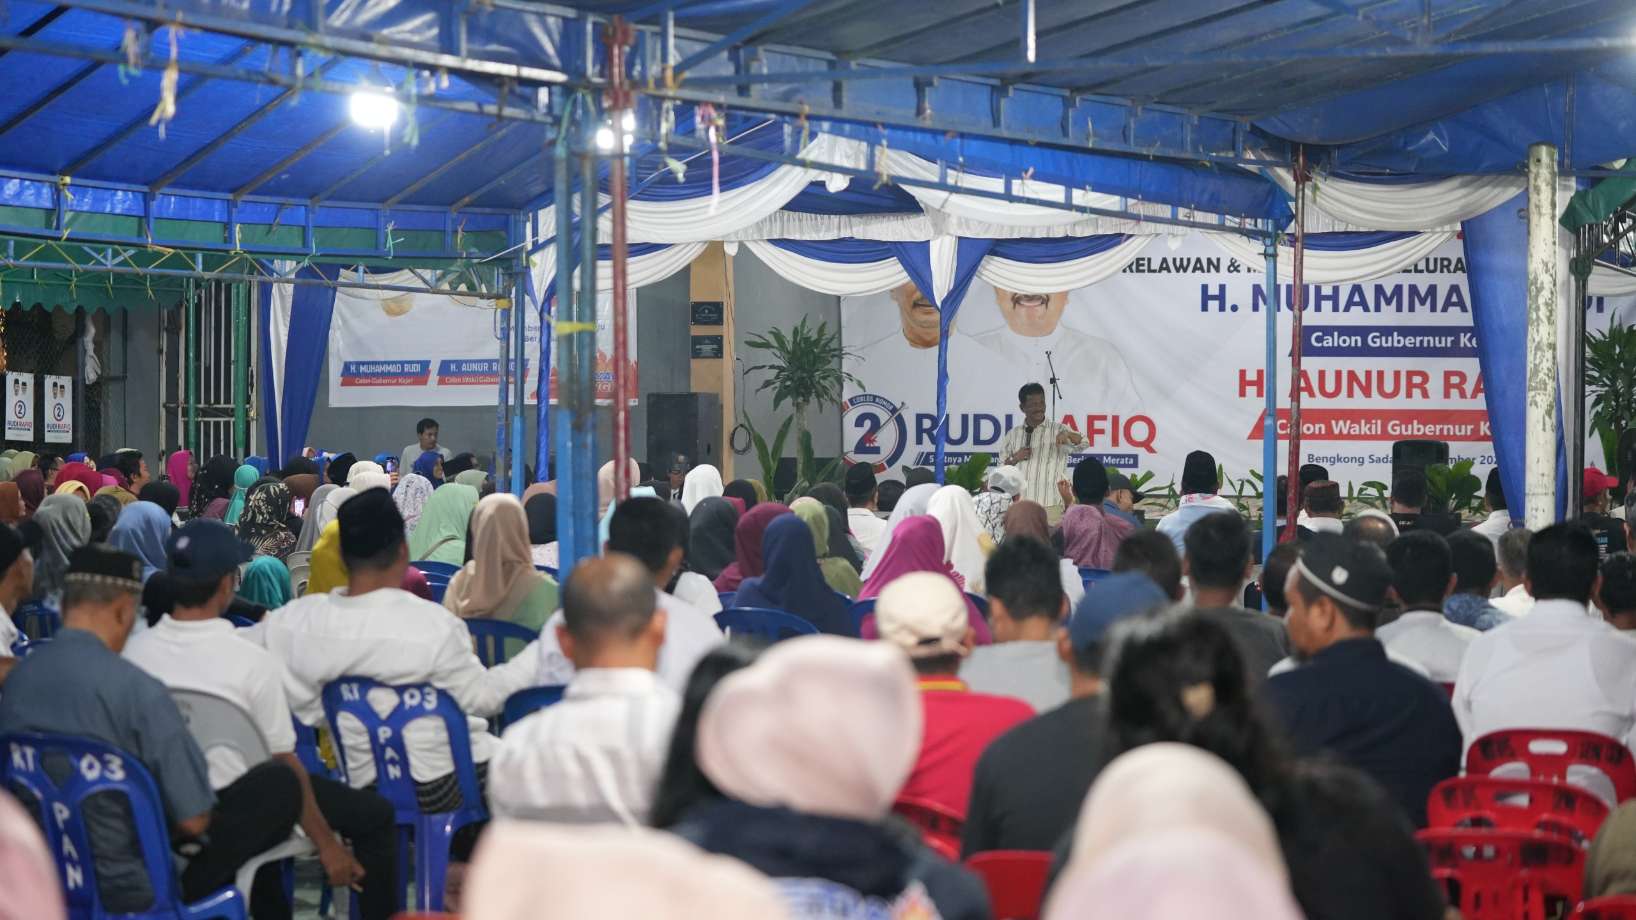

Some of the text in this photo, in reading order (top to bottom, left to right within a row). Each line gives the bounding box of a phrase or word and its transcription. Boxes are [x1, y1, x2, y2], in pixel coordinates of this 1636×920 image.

[1227, 257, 1240, 273] &
[1401, 257, 1466, 273] LURA
[1201, 284, 1238, 312] H.
[1311, 332, 1361, 347] Calon
[1368, 332, 1454, 348] Gubernur
[360, 364, 401, 373] MUHAMMAD
[404, 363, 420, 372] RUDI
[462, 363, 488, 371] AUNUR
[1289, 370, 1429, 399] AUNUR
[18, 405, 23, 415] 2
[57, 409, 61, 418] 2
[854, 412, 881, 455] 2
[915, 413, 1012, 446] RUDI
[1331, 419, 1381, 435] Wakil
[1387, 420, 1474, 436] Gubernur
[1103, 456, 1134, 464] Merata
[1307, 454, 1365, 467] Bengkong
[340, 683, 359, 701] RT
[10, 742, 126, 781] RT 03
